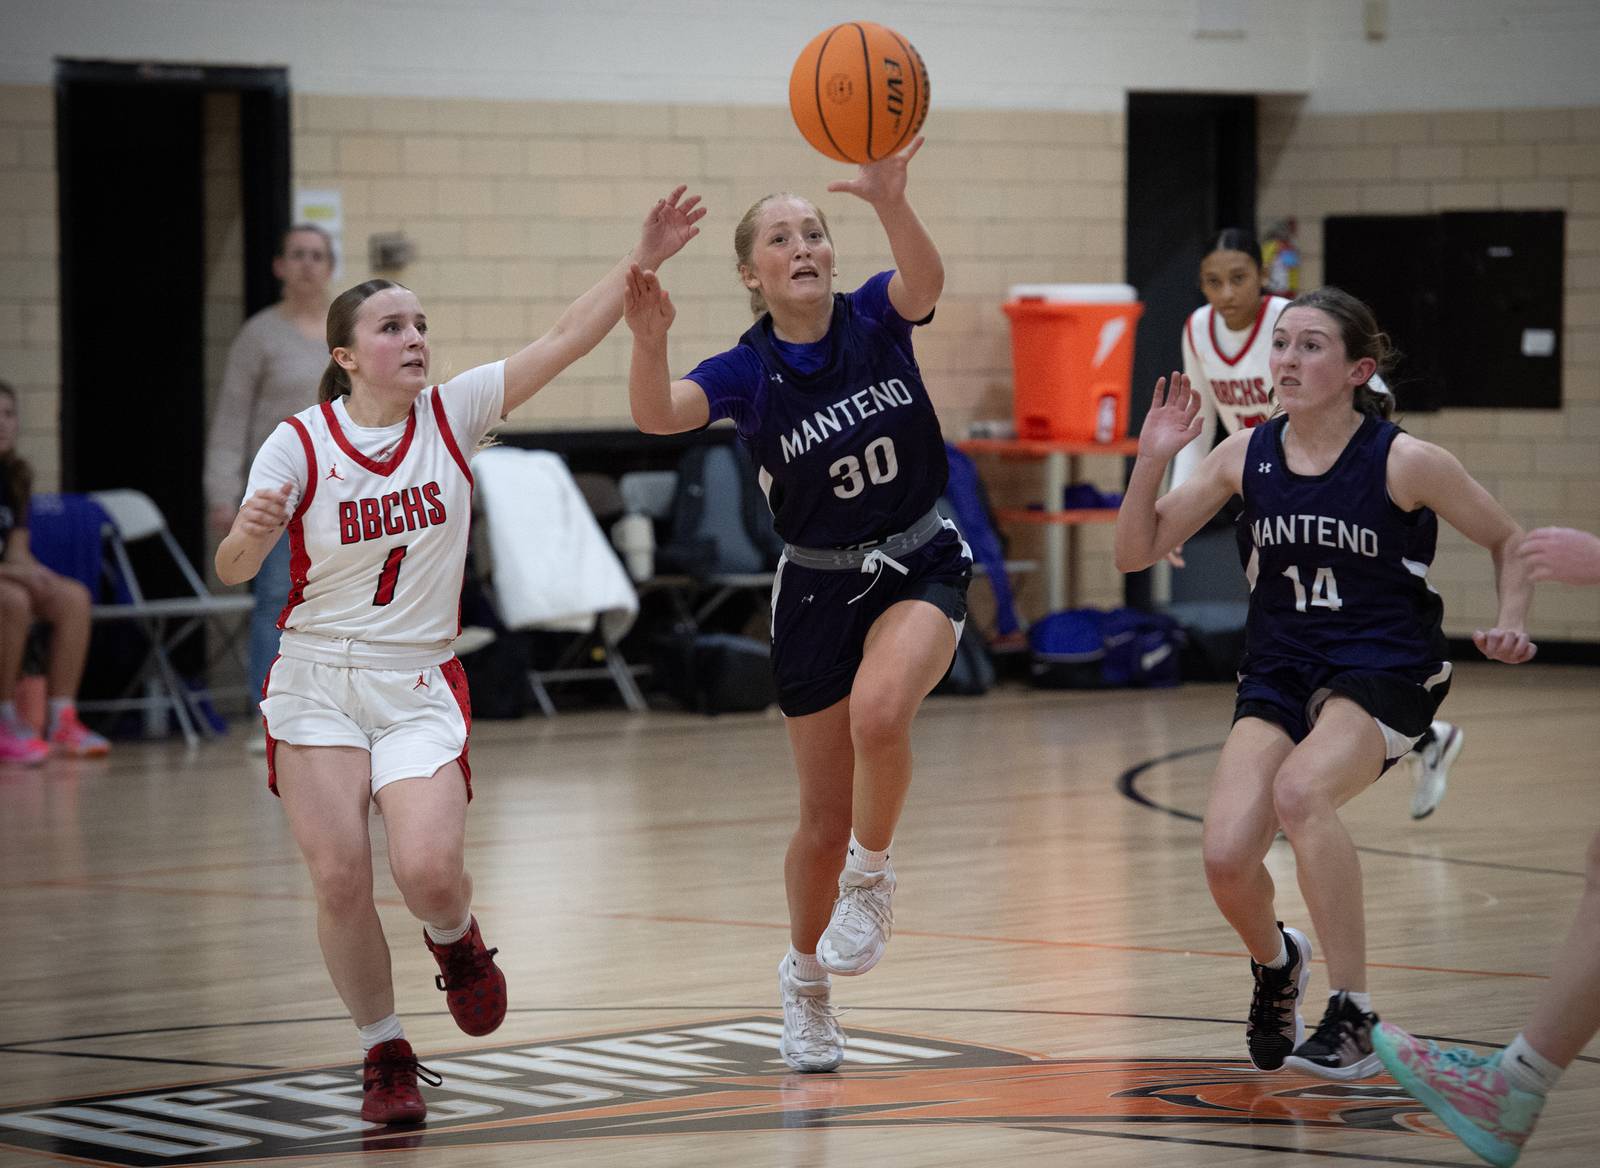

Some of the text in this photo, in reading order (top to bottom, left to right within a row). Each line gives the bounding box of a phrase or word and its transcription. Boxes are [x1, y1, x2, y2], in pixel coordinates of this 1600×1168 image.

[780, 378, 913, 464] MANTENO
[828, 436, 899, 499] 30
[339, 481, 447, 545] BBCHS
[1250, 514, 1378, 557] MANTENO
[372, 545, 408, 606] 1
[1281, 565, 1343, 612] 14
